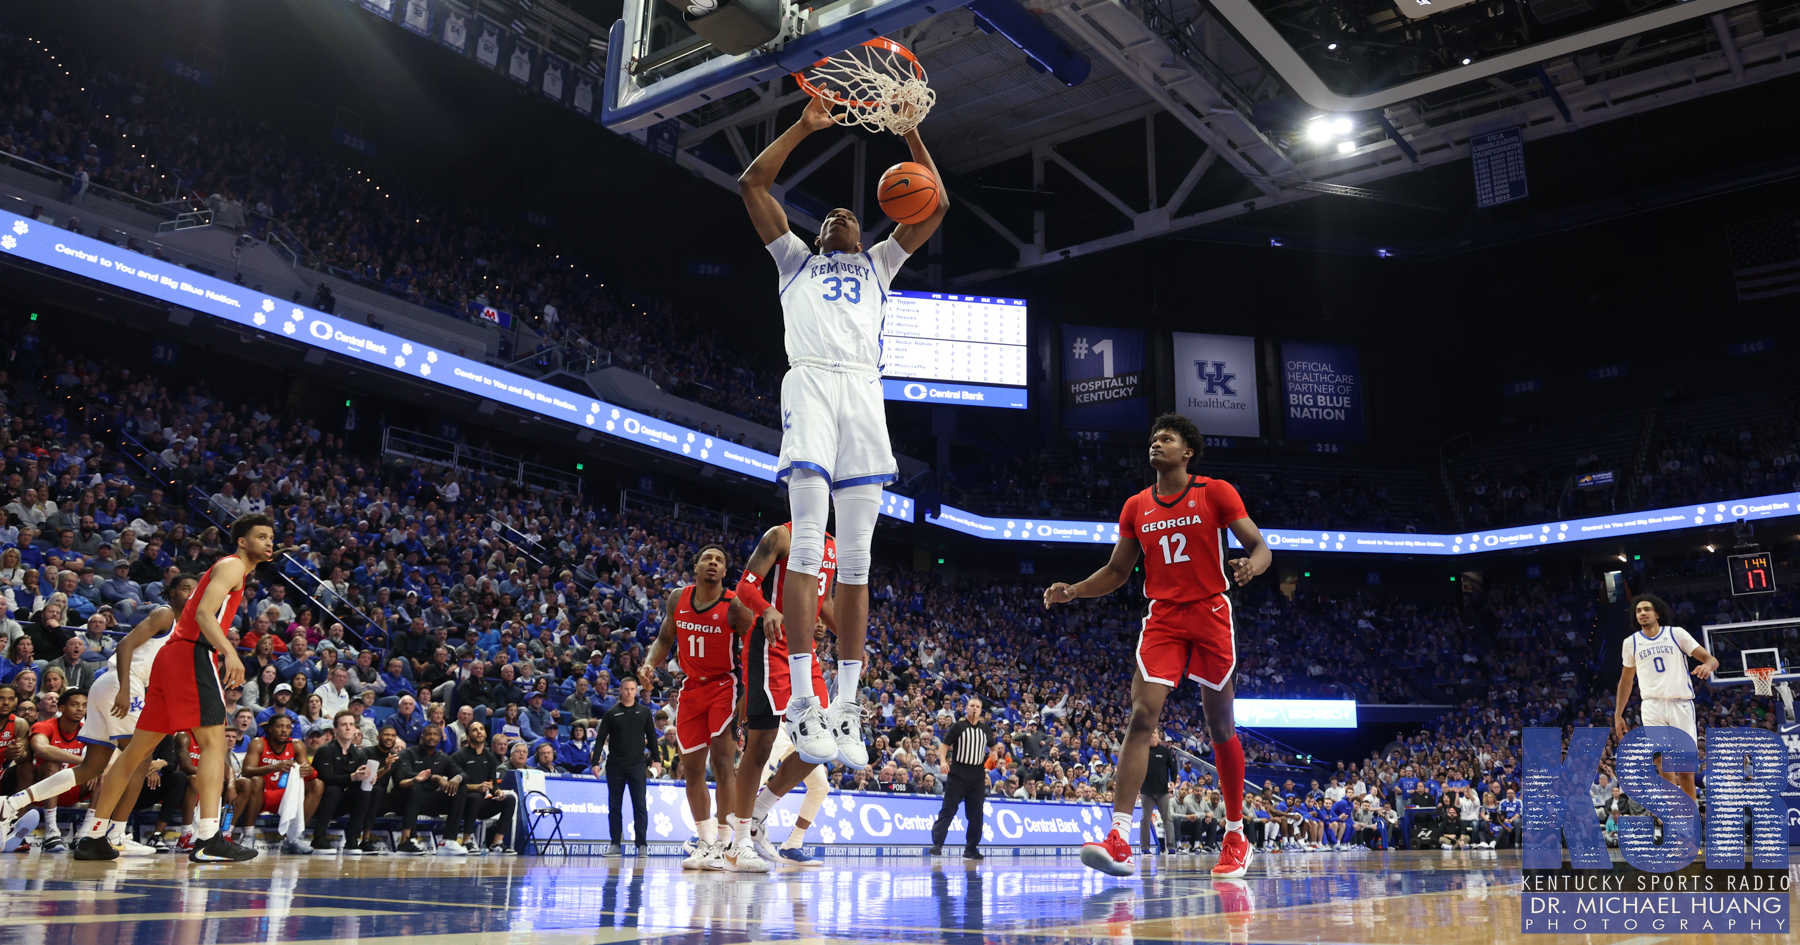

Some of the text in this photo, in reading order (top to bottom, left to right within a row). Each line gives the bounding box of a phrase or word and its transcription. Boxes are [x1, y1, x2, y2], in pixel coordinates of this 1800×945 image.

[1487, 133, 1504, 142] UCA
[55, 243, 242, 308] Central to You and Big Blue Nation.
[811, 262, 869, 280] KENTUCKY
[823, 277, 860, 304] 33
[334, 330, 387, 354] Central Bank
[1073, 337, 1114, 378] #1
[1287, 361, 1334, 373] OFFICIAL
[1071, 376, 1138, 394] HOSPITAL IN
[1194, 360, 1237, 396] UK
[1288, 372, 1354, 384] HEALTHCARE
[454, 367, 577, 412] Central to You and Big Blue Nation.
[930, 389, 984, 401] Central Bank
[1075, 386, 1134, 404] KENTUCKY
[1288, 383, 1353, 395] PARTNER OF
[1188, 398, 1246, 410] HealthCare
[1290, 394, 1352, 408] BIG BLUE
[1290, 408, 1346, 421] NATION
[640, 425, 678, 444] Central Bank
[724, 450, 745, 464] Central
[751, 459, 761, 469] You
[762, 462, 773, 471] and
[1749, 502, 1789, 513] Central Bank
[1141, 515, 1202, 533] GEORGIA
[1581, 524, 1603, 532] Central
[1611, 522, 1624, 530] You
[1624, 520, 1636, 528] and
[1637, 518, 1648, 527] Big
[1648, 516, 1663, 524] Blue
[1663, 514, 1685, 523] Nation.
[1053, 528, 1072, 536] Central
[1499, 532, 1533, 543] Central Bank
[1159, 533, 1191, 565] 12
[1747, 569, 1767, 588] 17
[676, 620, 722, 634] GEORGIA
[688, 635, 704, 658] 11
[1639, 646, 1674, 660] KENTUCKY
[1653, 657, 1665, 673] 0
[555, 801, 609, 814] Central Bank
[894, 813, 934, 831] Central
[1024, 818, 1080, 832] Central Bank
[572, 845, 588, 855] FARM
[625, 845, 635, 855] BIG
[647, 845, 684, 855] COMMITMENT
[825, 848, 876, 856] KENTUCKY FARM BUREAU
